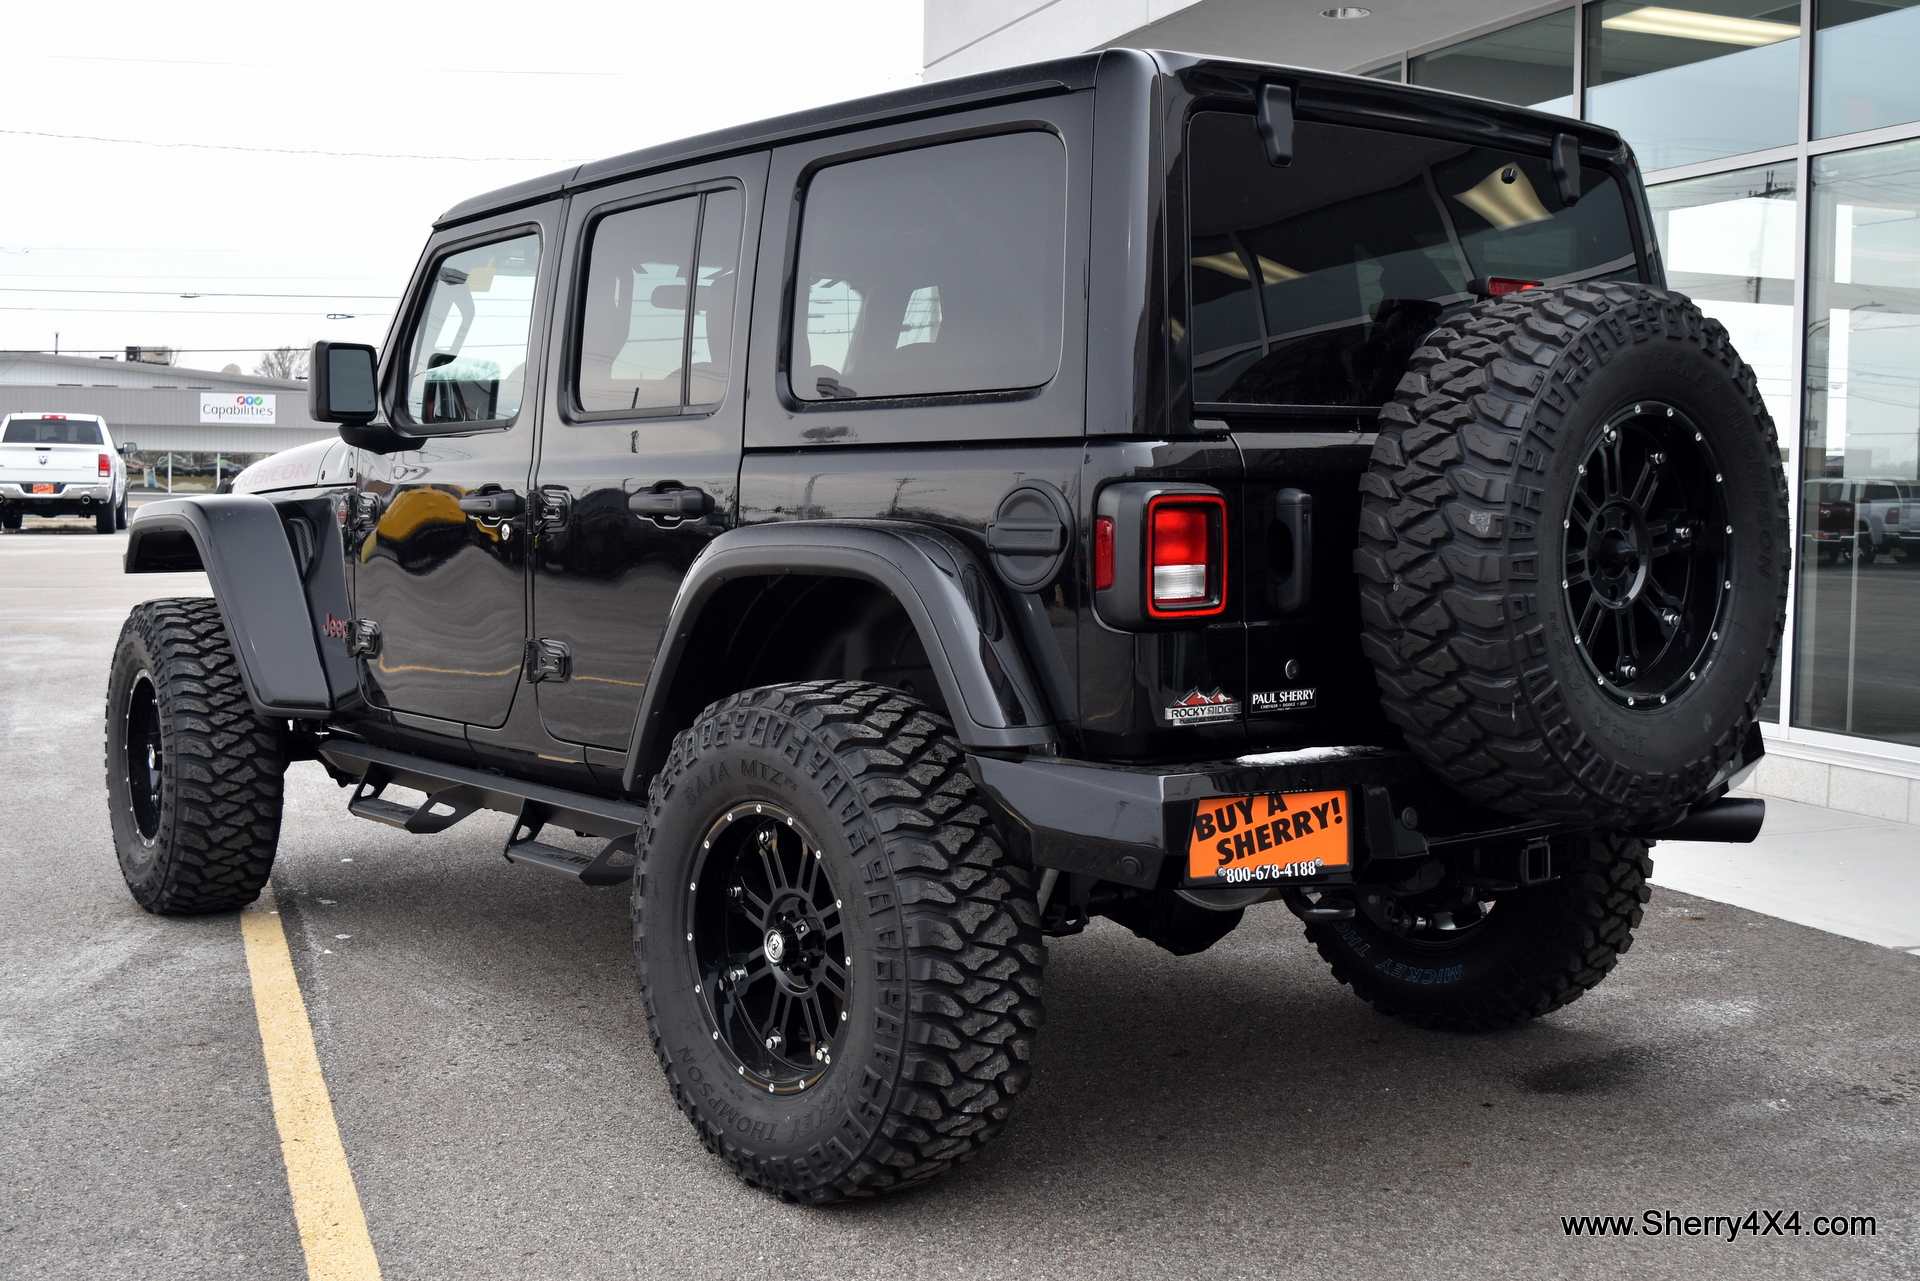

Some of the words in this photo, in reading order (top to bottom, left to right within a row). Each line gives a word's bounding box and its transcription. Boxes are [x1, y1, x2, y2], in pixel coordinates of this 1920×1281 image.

[203, 403, 274, 420] Capabilities
[235, 459, 313, 489] RUBICON
[1252, 692, 1277, 705] PAUL
[1279, 689, 1315, 703] SHERRY
[683, 761, 731, 809] BAJA
[740, 758, 784, 788] MTZ
[1195, 795, 1255, 842] BUY
[1267, 794, 1288, 817] A
[1216, 797, 1344, 866] SHERRY!
[1226, 860, 1316, 884] 800-678-4188
[1375, 957, 1463, 985] MICKEY
[677, 1046, 778, 1144] THOMPSON
